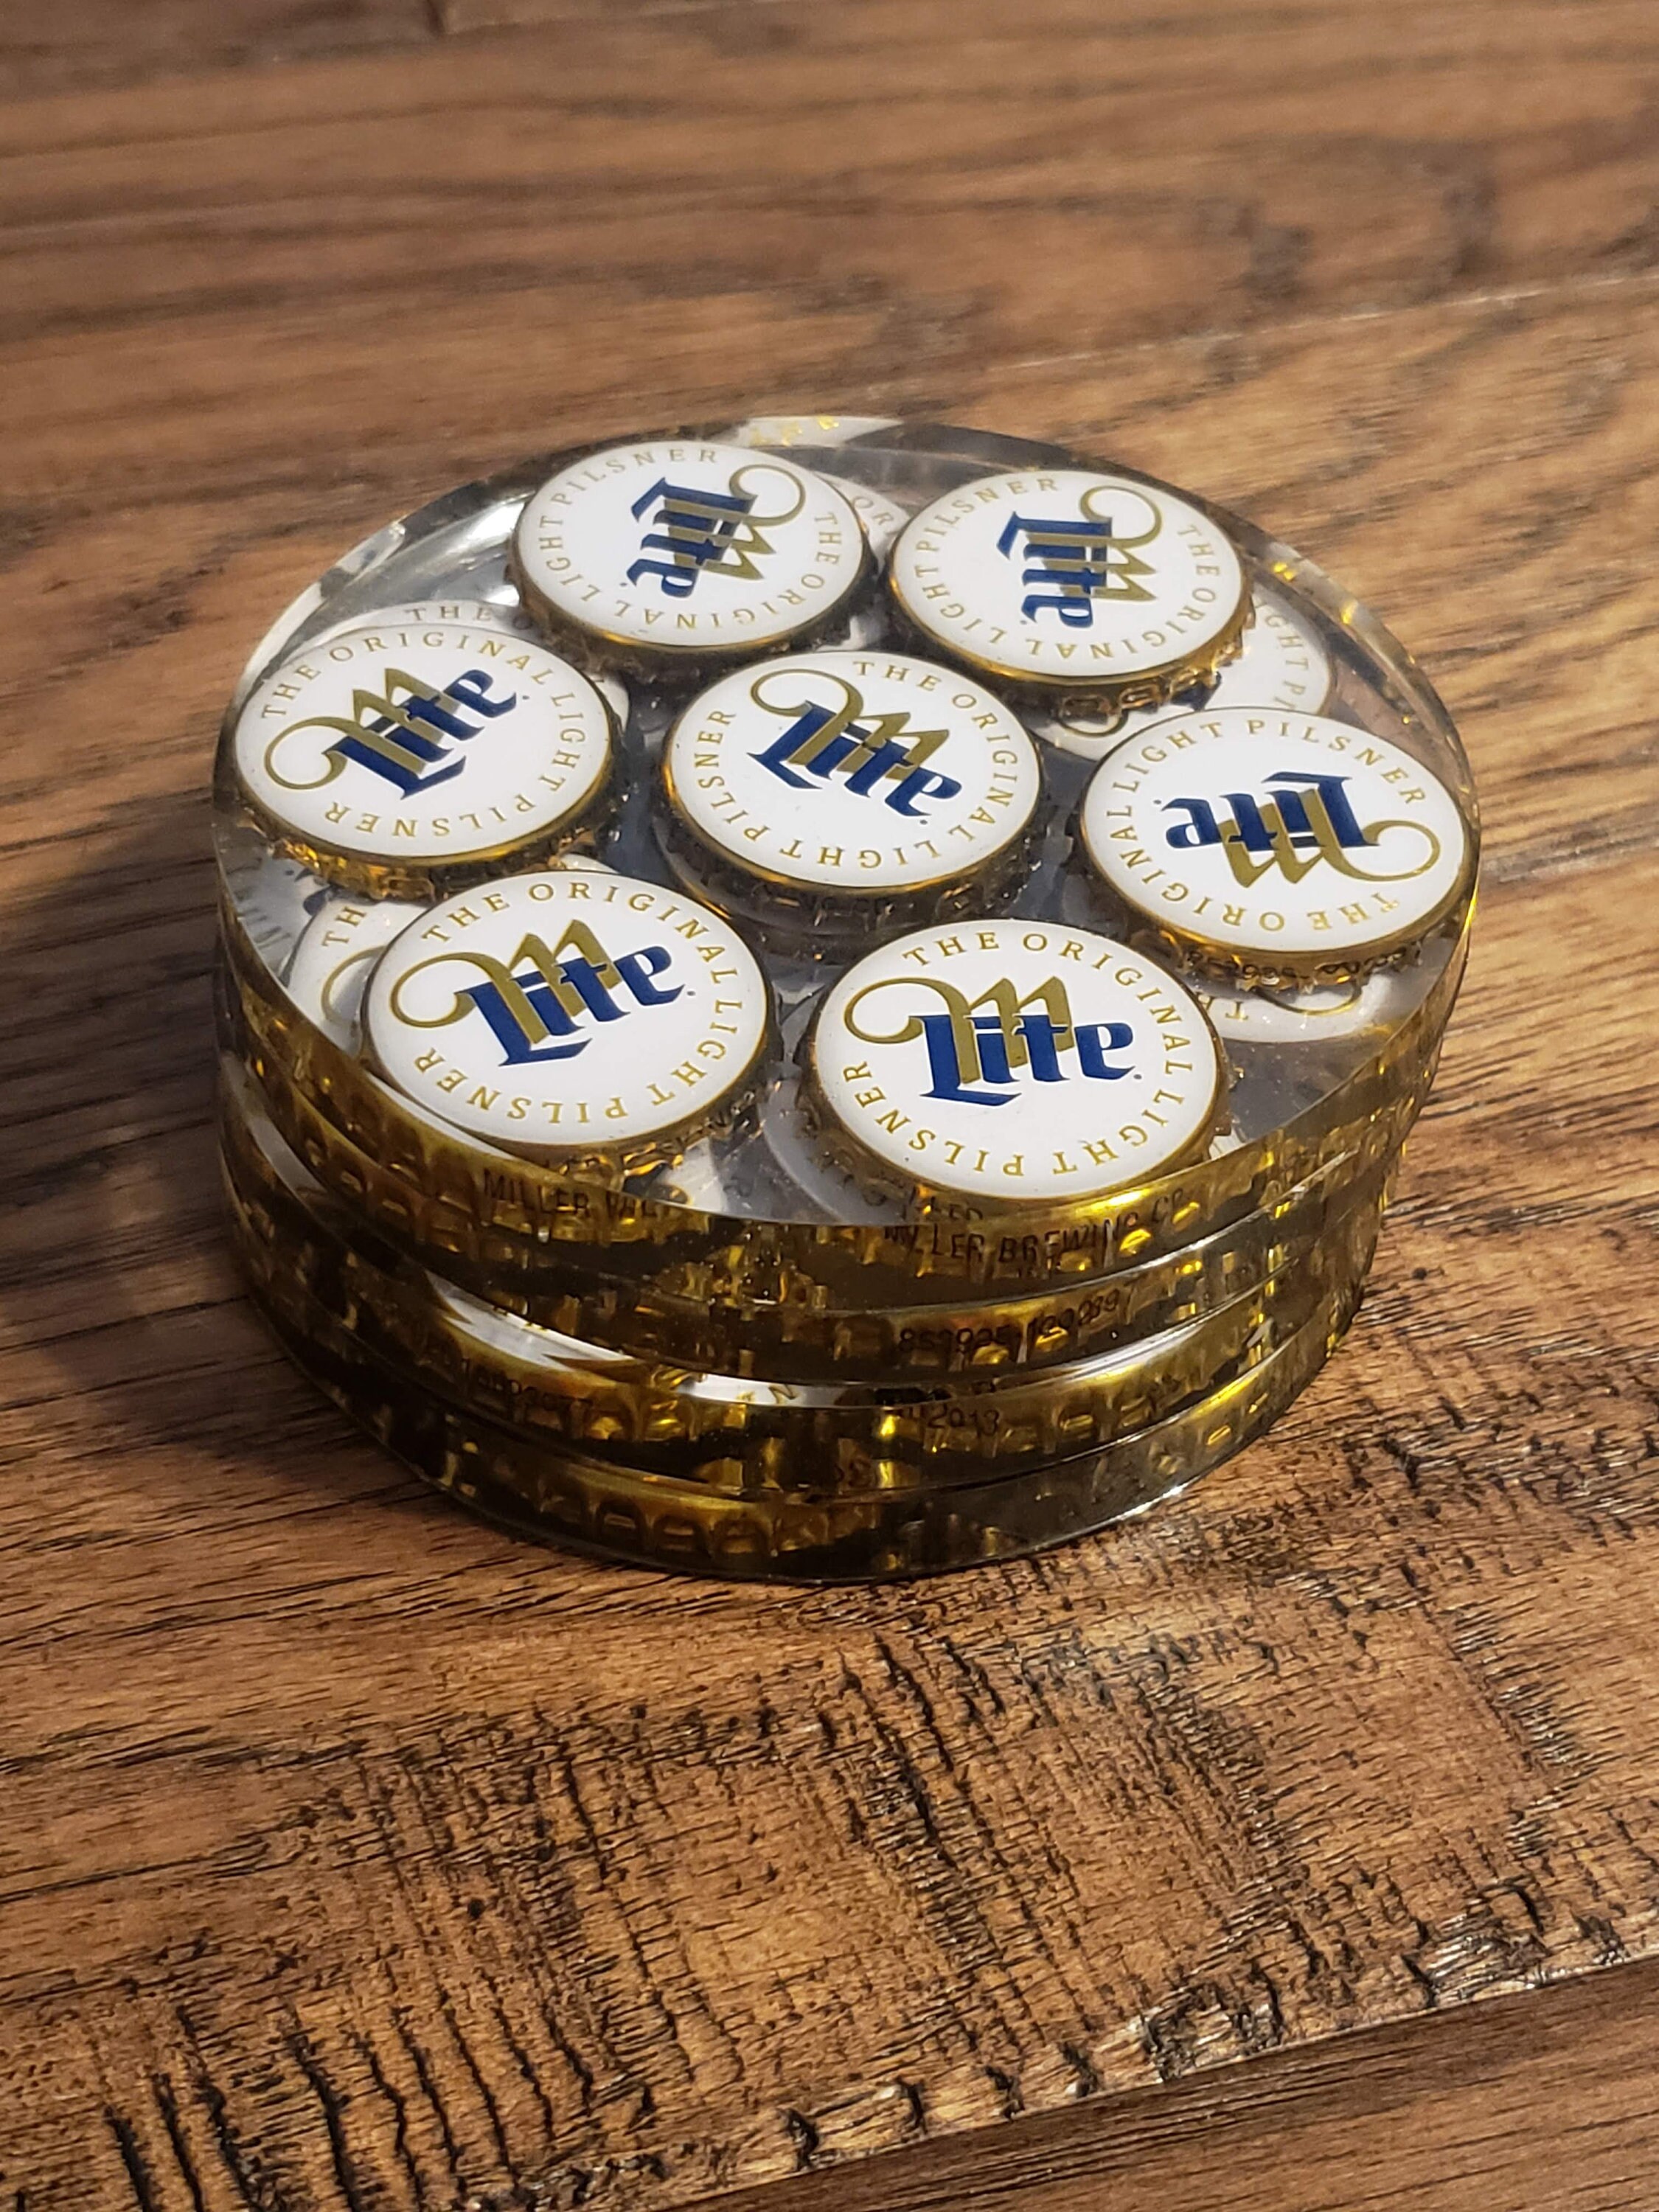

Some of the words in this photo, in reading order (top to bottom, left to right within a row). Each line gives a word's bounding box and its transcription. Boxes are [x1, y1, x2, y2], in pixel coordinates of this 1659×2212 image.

[552, 448, 717, 507] PILSNER
[917, 479, 1058, 551] PILSNER
[540, 515, 601, 602] LIGHT
[626, 477, 758, 597] Lite
[813, 512, 842, 565] THE
[997, 512, 1112, 627] Lite
[1178, 525, 1220, 577] THE
[404, 605, 493, 622] THE
[614, 573, 824, 628] ORIGINAL
[916, 565, 1008, 644] LIGHT
[1026, 588, 1216, 658] ORIGINAL
[1255, 600, 1309, 669] IGHT
[262, 665, 320, 718] THE
[330, 632, 553, 685] ORIGINAL
[853, 661, 941, 691] THE
[321, 669, 517, 800] Lite
[539, 692, 585, 791] LIGHT
[748, 700, 961, 816] Lite
[949, 694, 1018, 842] ORIGINAL
[1113, 722, 1223, 793] LIGHT
[1248, 719, 1427, 804] PILSNER
[695, 710, 772, 841] PILSNER
[1161, 771, 1379, 851] Lite
[326, 794, 535, 837] PILSNER
[779, 839, 941, 869] LIGHT
[1107, 805, 1284, 931] ORIGINAL
[321, 905, 367, 947] TH
[422, 894, 510, 944] THE
[529, 882, 737, 984] ORIGINAL
[902, 932, 999, 967] THE
[1307, 892, 1399, 931] THE
[454, 946, 685, 1066] Lite
[1023, 933, 1192, 1074] ORIGINAL
[414, 1048, 627, 1124] PILSNER
[647, 999, 742, 1107] LIGHT
[908, 1015, 1135, 1106] Lite
[843, 1062, 1024, 1177] PILSNER
[1053, 1088, 1185, 1175] LIGHT
